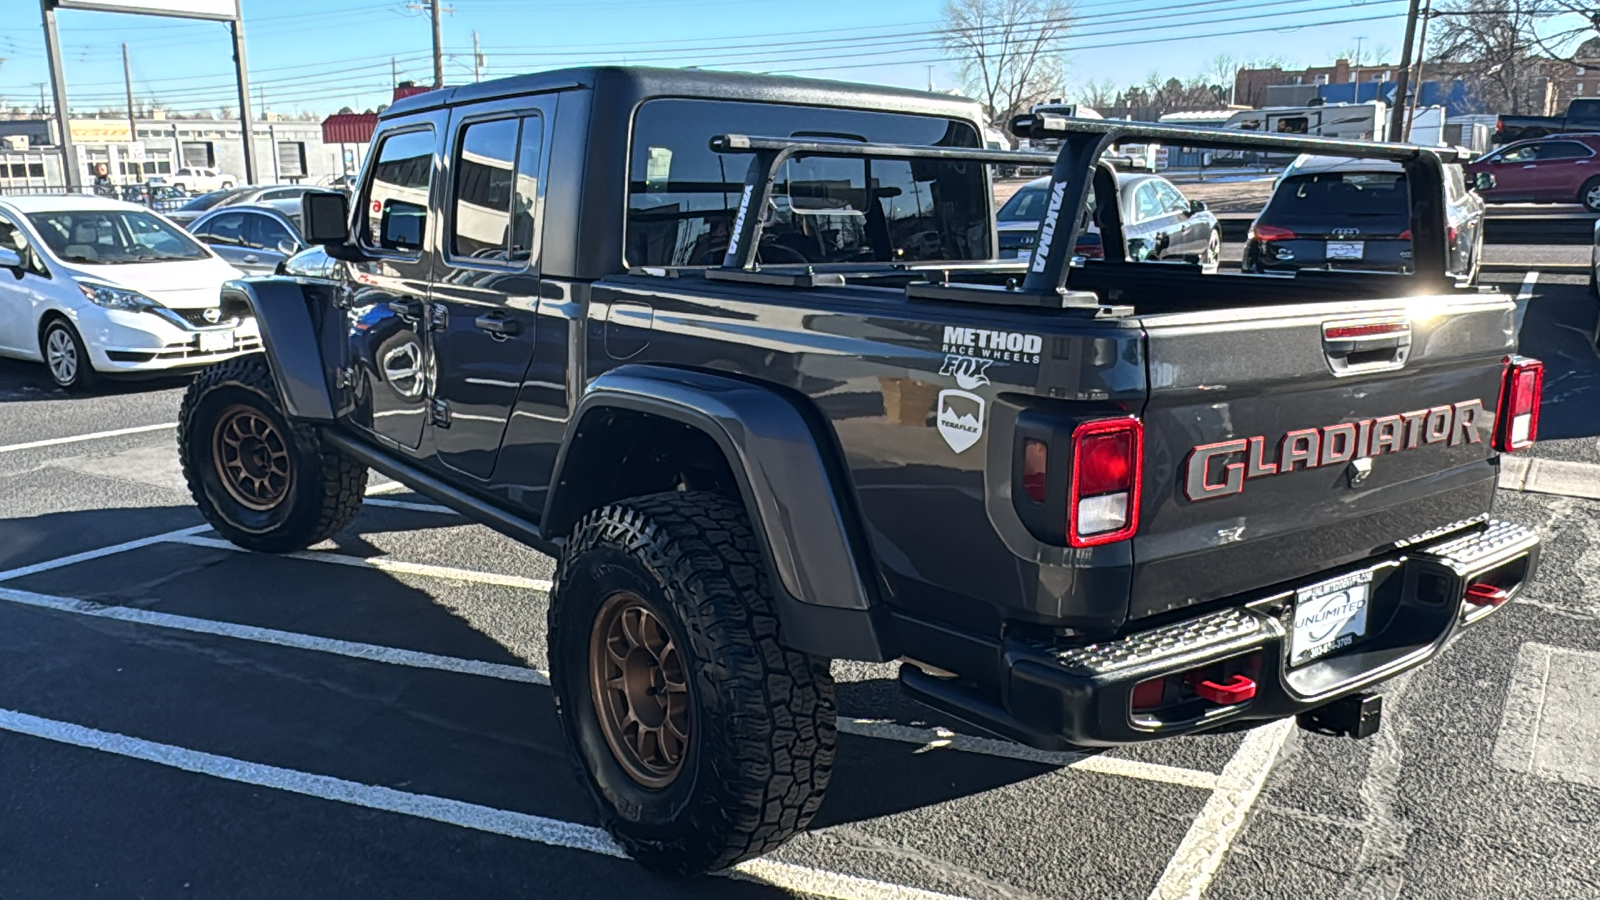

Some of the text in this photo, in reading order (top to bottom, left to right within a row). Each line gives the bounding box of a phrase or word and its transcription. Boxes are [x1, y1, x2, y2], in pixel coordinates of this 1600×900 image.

[728, 184, 754, 255] YAKIMA
[1032, 181, 1067, 273] YAKIMA
[942, 344, 1040, 364] RACE WHEELS
[943, 326, 1042, 354] METHOD
[938, 354, 994, 380] FOX
[941, 420, 979, 434] TERAFLEX
[1184, 398, 1483, 502] GLADIATOR
[1295, 599, 1366, 629] UNLIMITED
